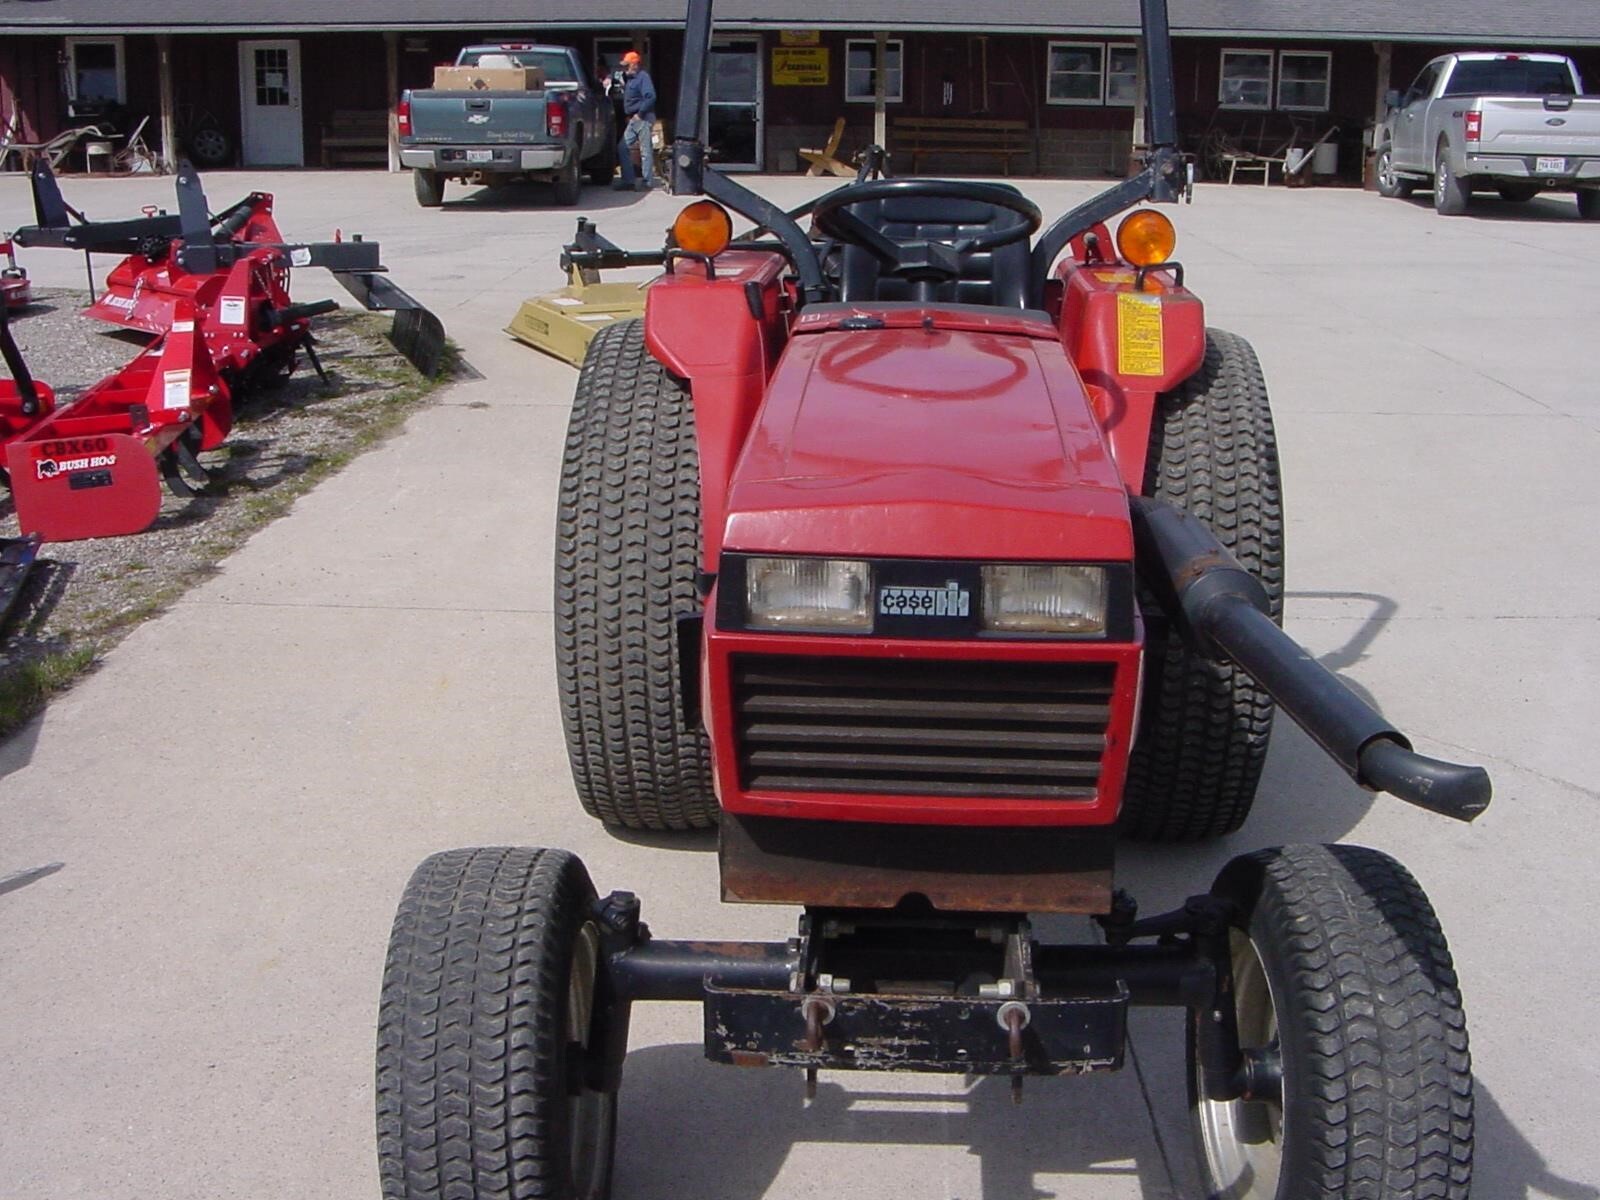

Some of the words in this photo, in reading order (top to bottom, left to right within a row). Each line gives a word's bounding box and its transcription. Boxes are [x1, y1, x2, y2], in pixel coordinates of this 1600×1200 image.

[43, 438, 107, 455] CBX60
[59, 458, 89, 471] BUSH
[90, 455, 116, 467] HOG
